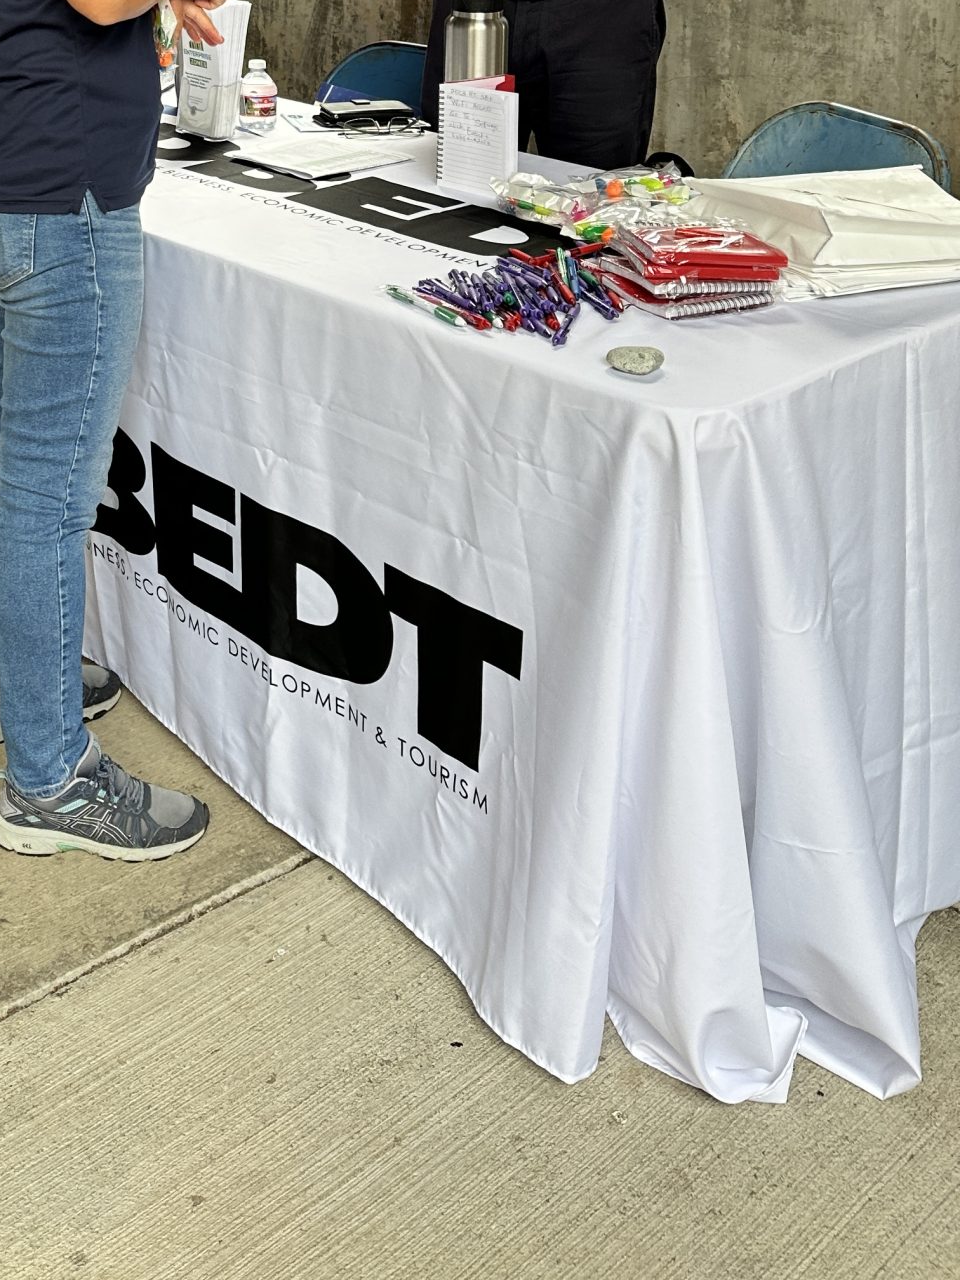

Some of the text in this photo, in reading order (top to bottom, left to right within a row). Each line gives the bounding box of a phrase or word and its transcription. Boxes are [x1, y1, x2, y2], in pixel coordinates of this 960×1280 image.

[240, 192, 345, 227] ECONOMIC
[345, 224, 499, 272] DEVELOPMENT
[133, 572, 220, 647] ECONOMIC
[227, 636, 368, 732] DEVELOPMENT
[375, 725, 388, 748] &
[397, 737, 490, 815] TOURISM
